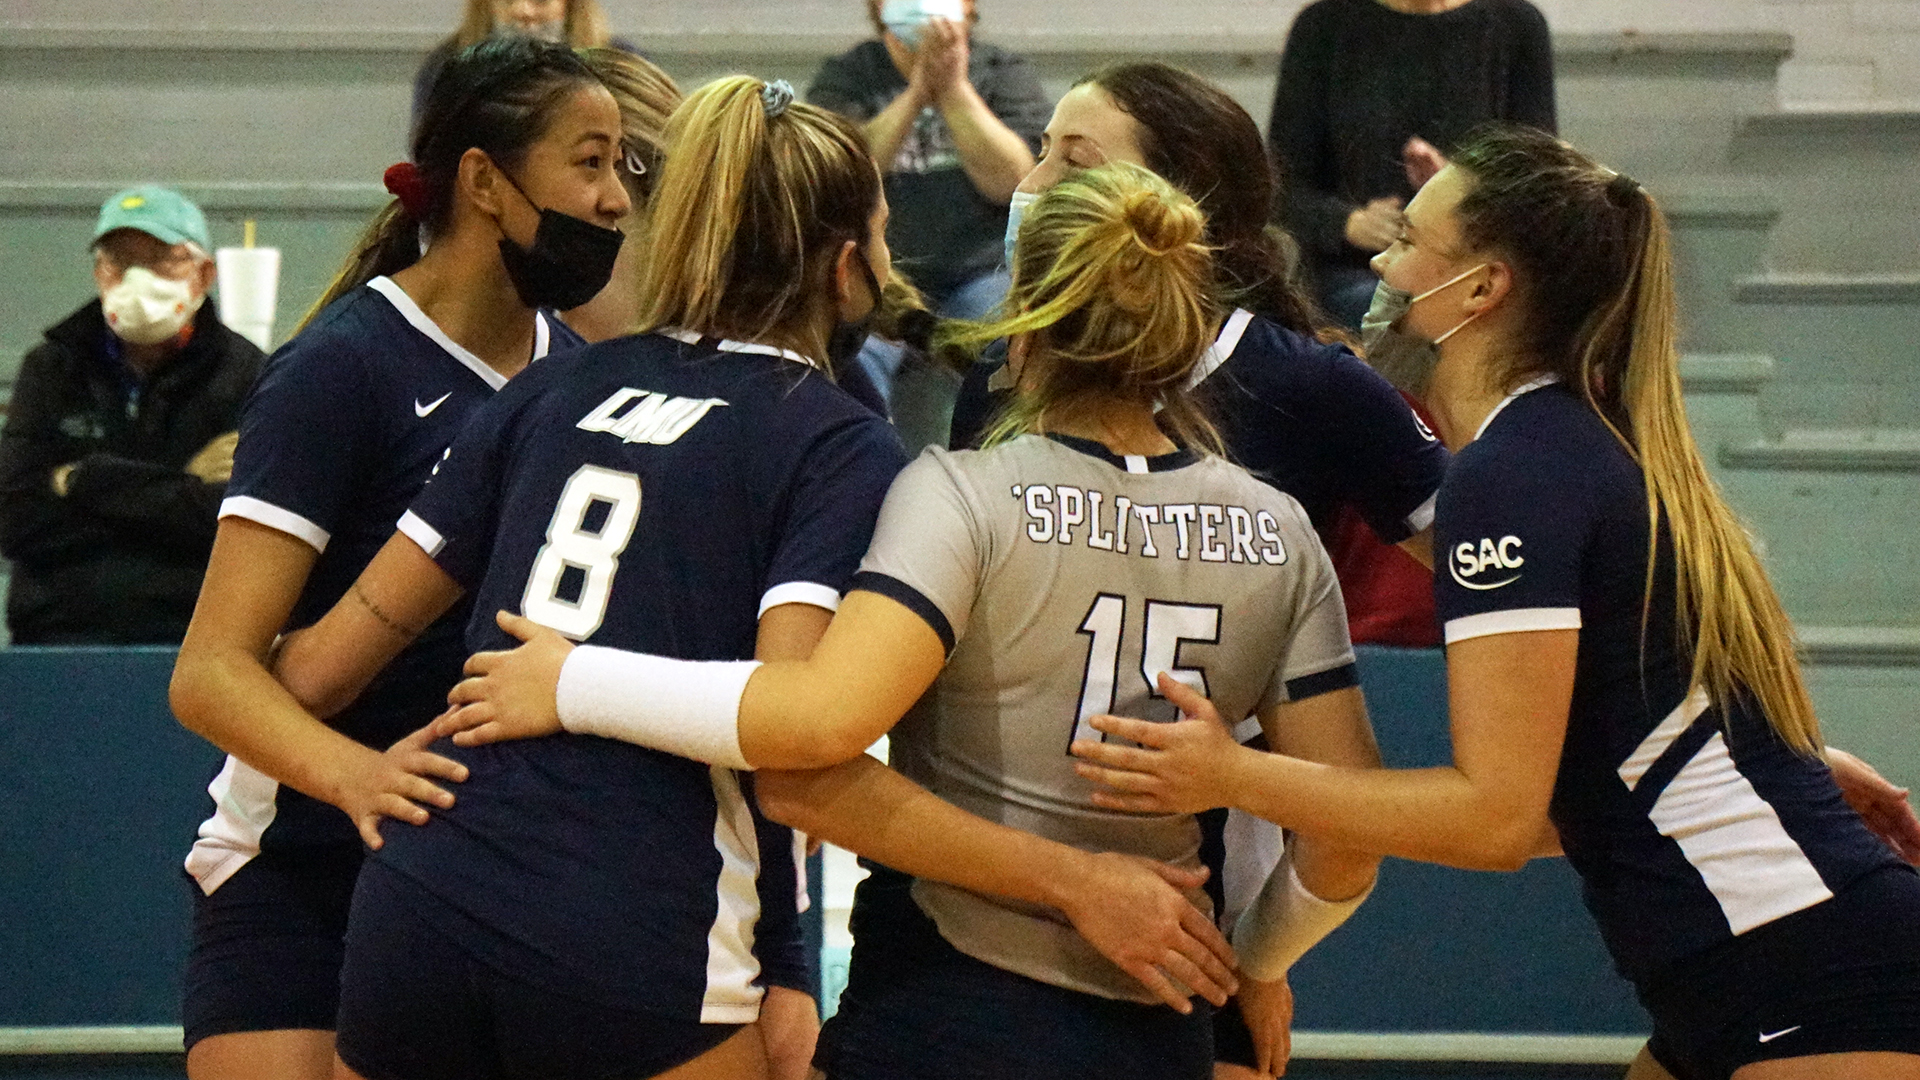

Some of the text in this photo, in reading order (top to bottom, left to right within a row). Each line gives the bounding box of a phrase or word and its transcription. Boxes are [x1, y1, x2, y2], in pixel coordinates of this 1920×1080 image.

[520, 464, 642, 641] 8
[1456, 535, 1524, 577] SAC
[1066, 591, 1223, 756] 15
